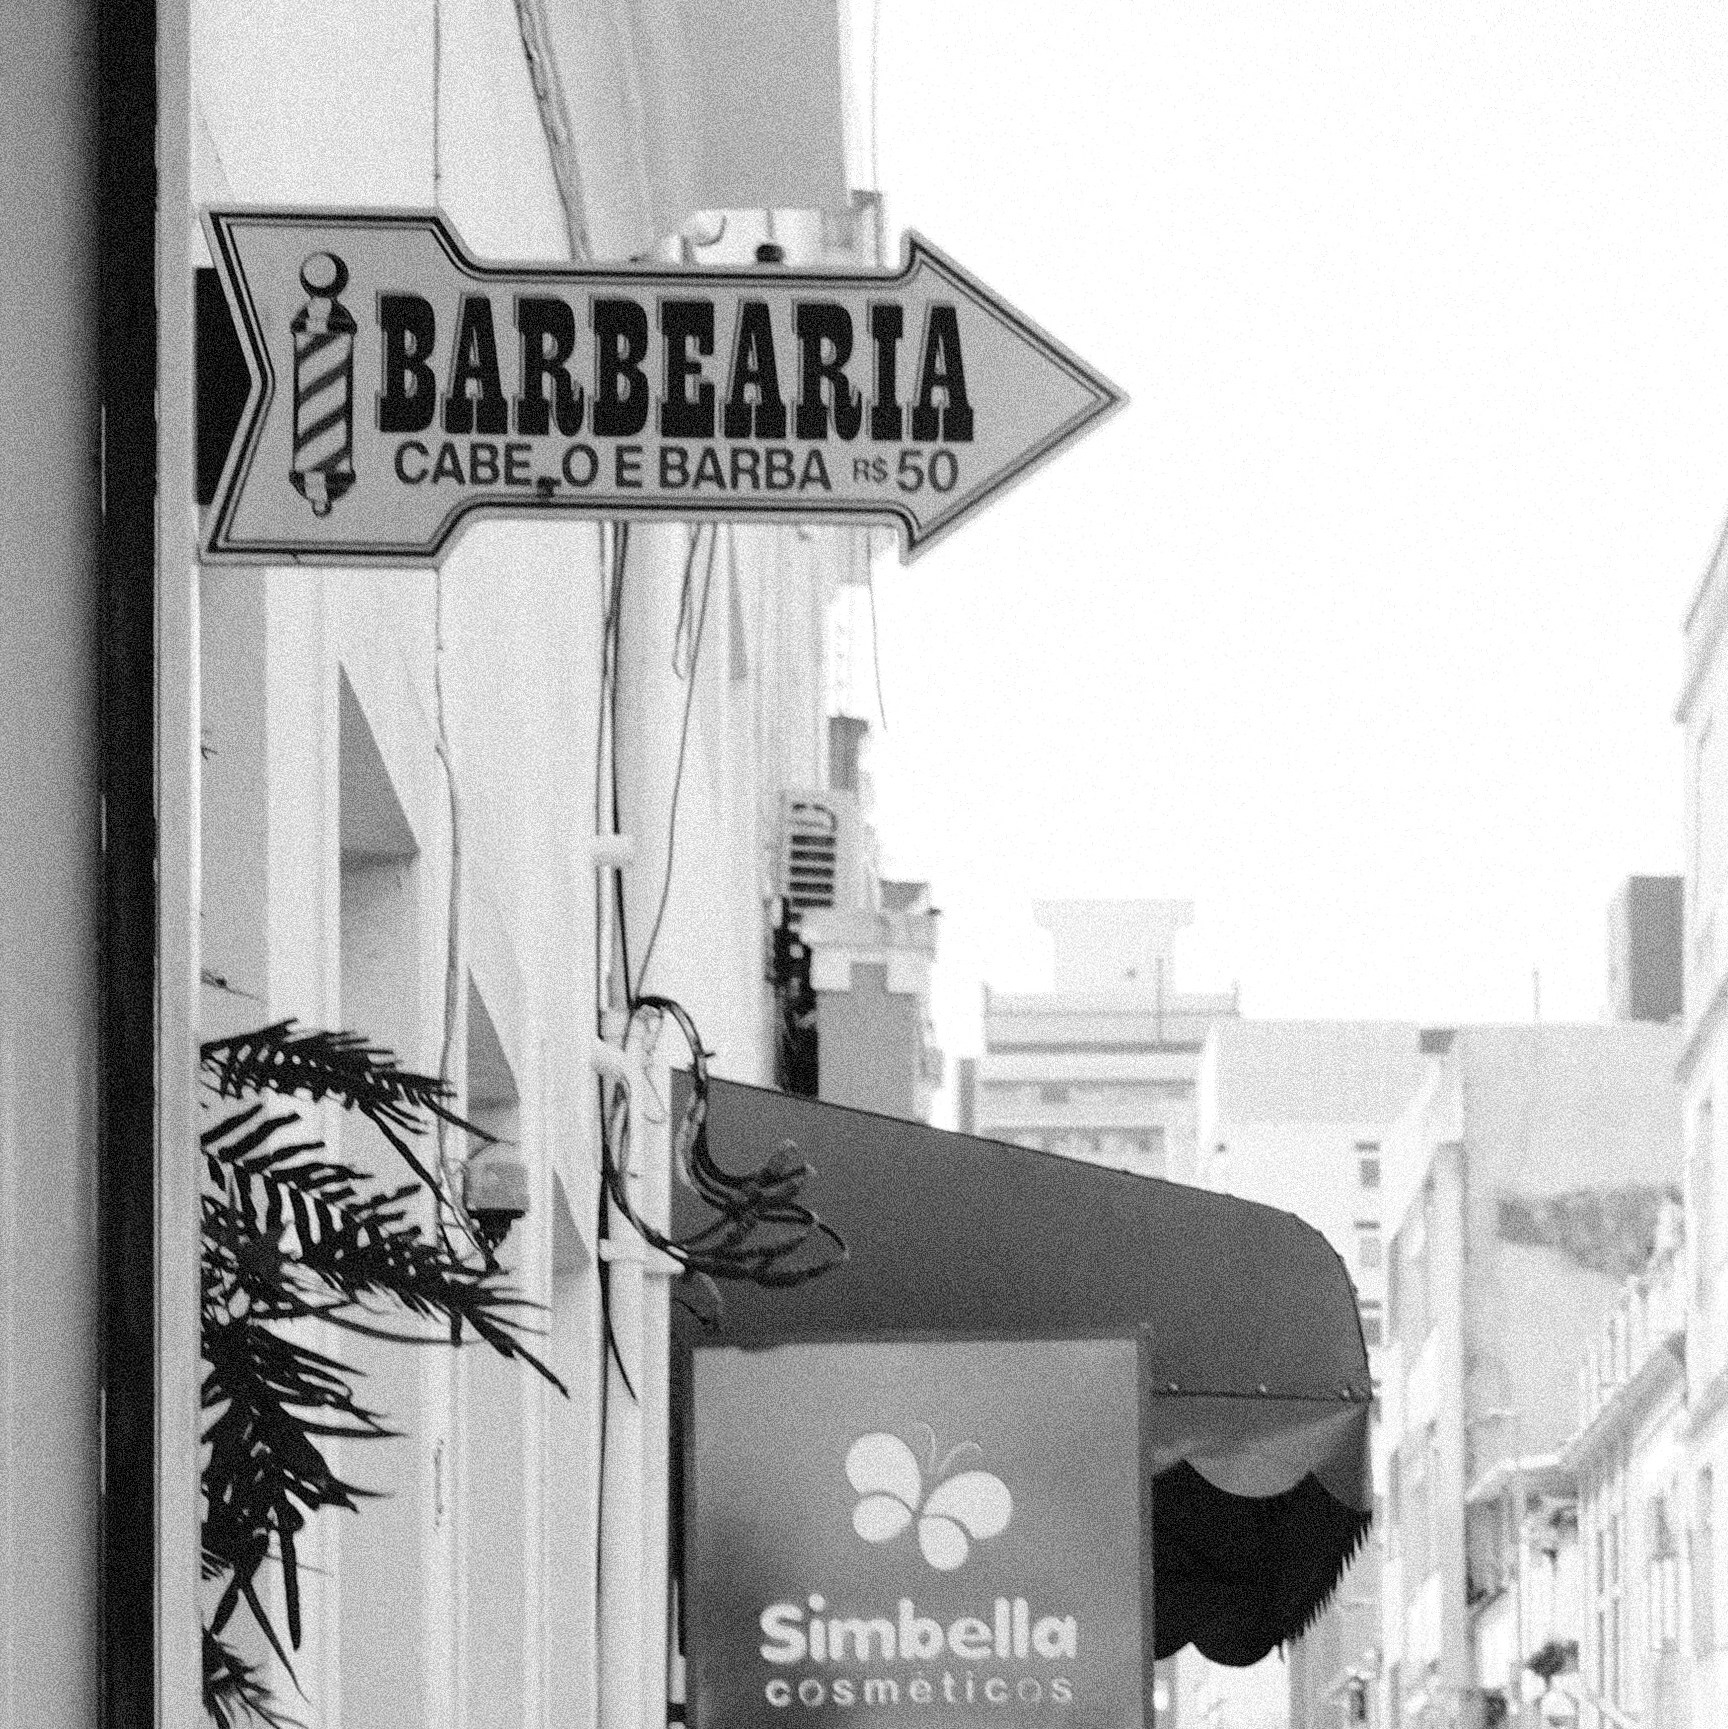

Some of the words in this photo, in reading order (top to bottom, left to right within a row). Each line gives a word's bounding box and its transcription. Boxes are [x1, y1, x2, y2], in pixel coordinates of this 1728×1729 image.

[376, 291, 975, 443] BARBEARIA
[614, 444, 643, 489] E
[658, 446, 832, 493] BARBA
[851, 455, 889, 488] R$
[896, 449, 961, 495] 50
[757, 1592, 1079, 1664] Simbella
[763, 1668, 1076, 1709] cosméticos
